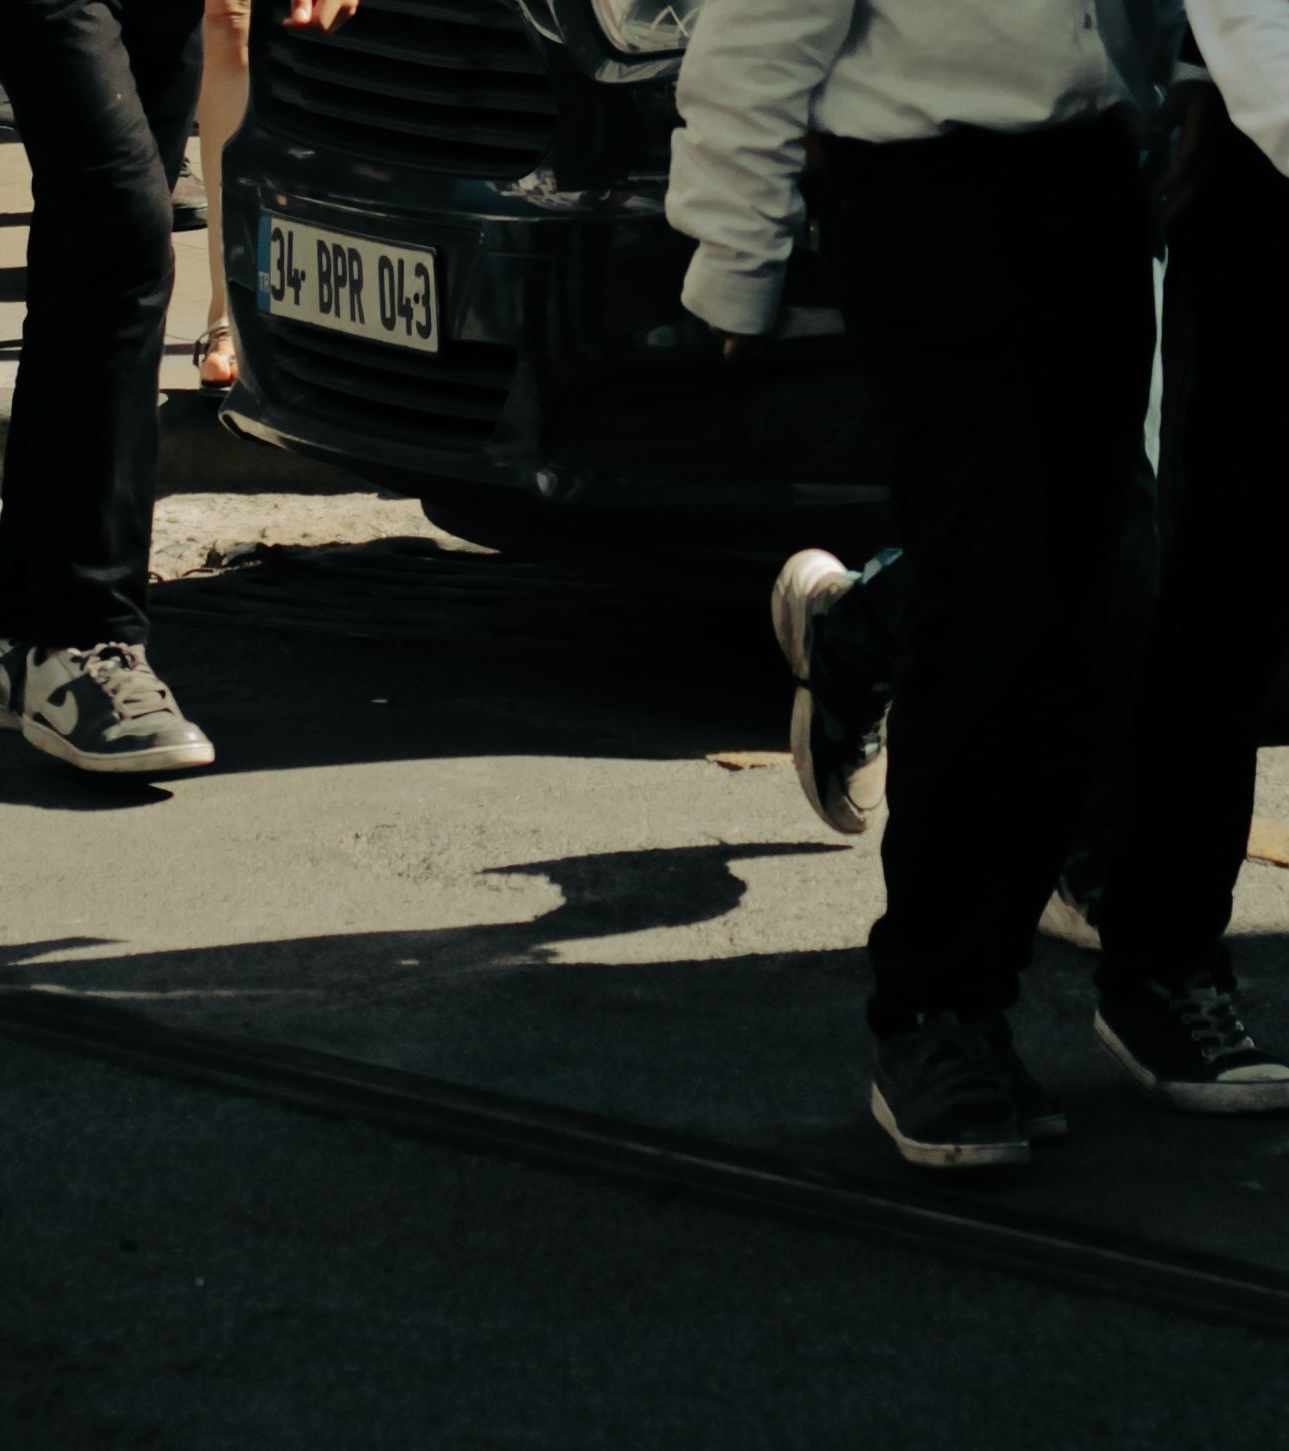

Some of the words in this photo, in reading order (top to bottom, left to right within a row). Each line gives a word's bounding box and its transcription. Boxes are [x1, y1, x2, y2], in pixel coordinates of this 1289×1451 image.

[271, 227, 301, 305] 34
[317, 239, 365, 325] BPR
[378, 255, 432, 339] 043
